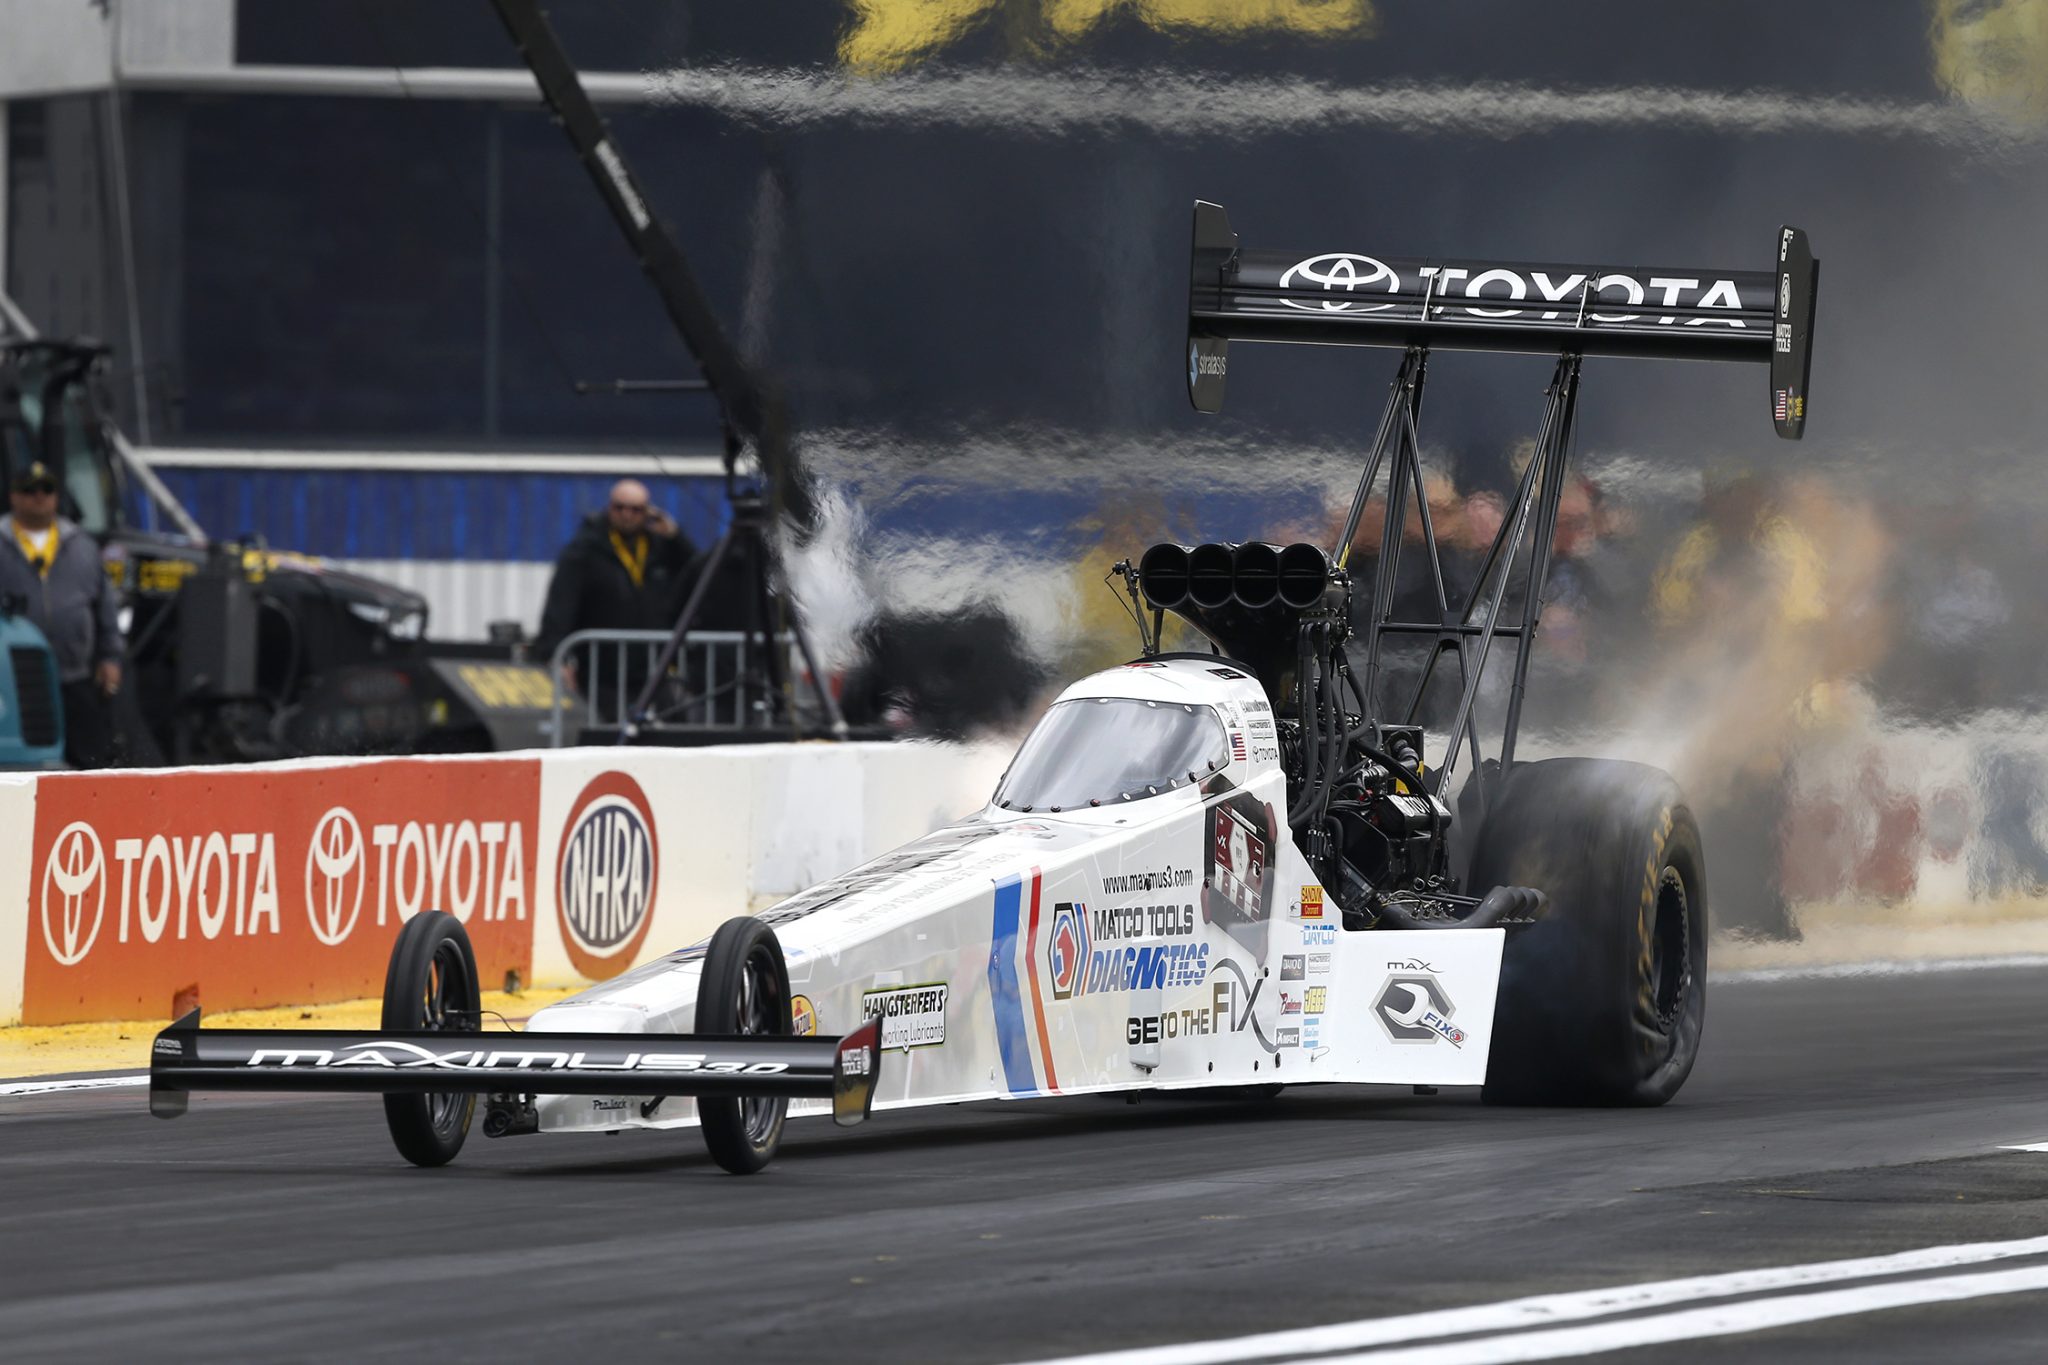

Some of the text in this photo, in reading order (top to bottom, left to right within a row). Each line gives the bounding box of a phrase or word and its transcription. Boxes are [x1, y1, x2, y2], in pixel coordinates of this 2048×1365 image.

[1418, 266, 1746, 328] TOYOTA
[114, 830, 281, 944] TOYOTA
[372, 818, 527, 927] TOYOTA
[569, 810, 645, 942] NHRA
[1102, 865, 1194, 895] www.maxmus3.com
[1093, 903, 1194, 942] MATCO TOOLS
[1181, 1008, 1210, 1037] THE
[1424, 1011, 1453, 1036] FIX
